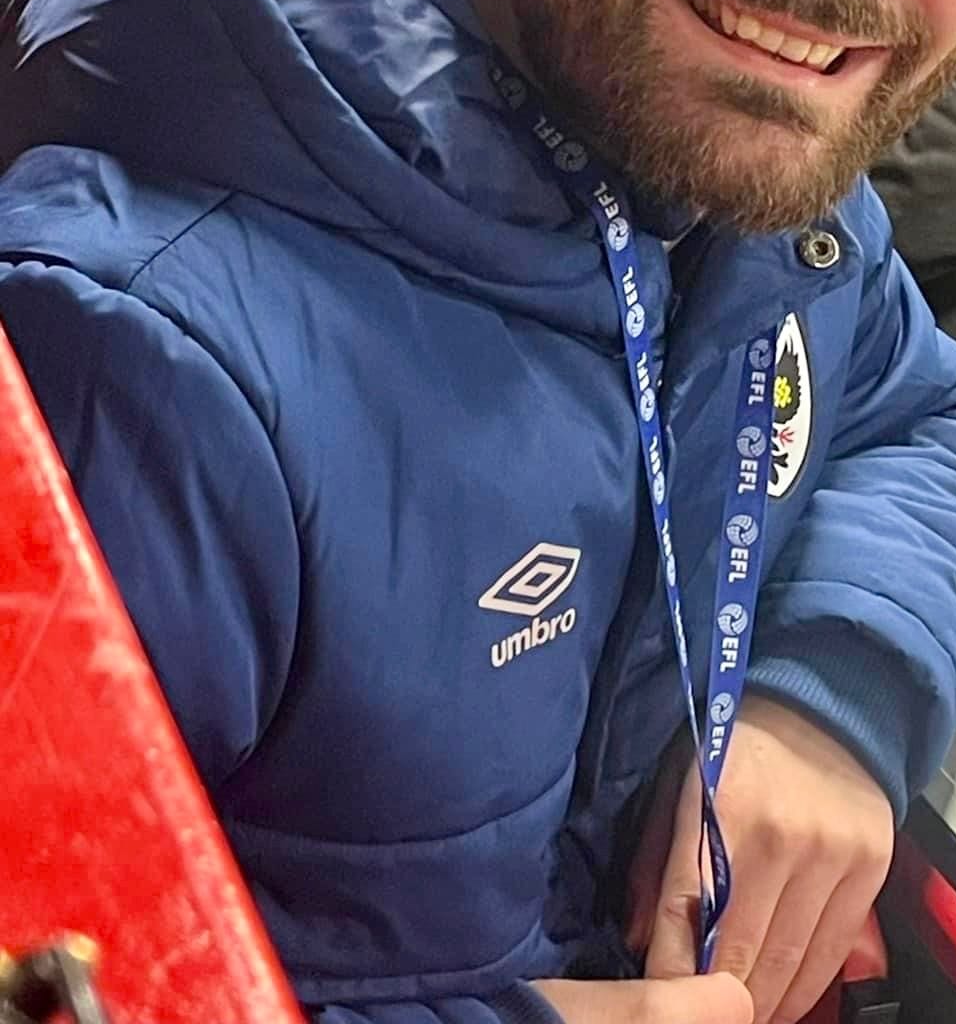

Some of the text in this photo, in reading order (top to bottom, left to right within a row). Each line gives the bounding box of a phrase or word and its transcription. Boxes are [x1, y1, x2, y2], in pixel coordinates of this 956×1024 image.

[593, 181, 620, 219] EFL
[622, 266, 640, 306] EFL
[747, 371, 766, 406] EFL
[737, 459, 758, 495] EFL
[728, 546, 749, 583] EFL
[491, 607, 577, 668] umbro
[719, 637, 740, 673] EFL
[709, 726, 725, 762] EFL
